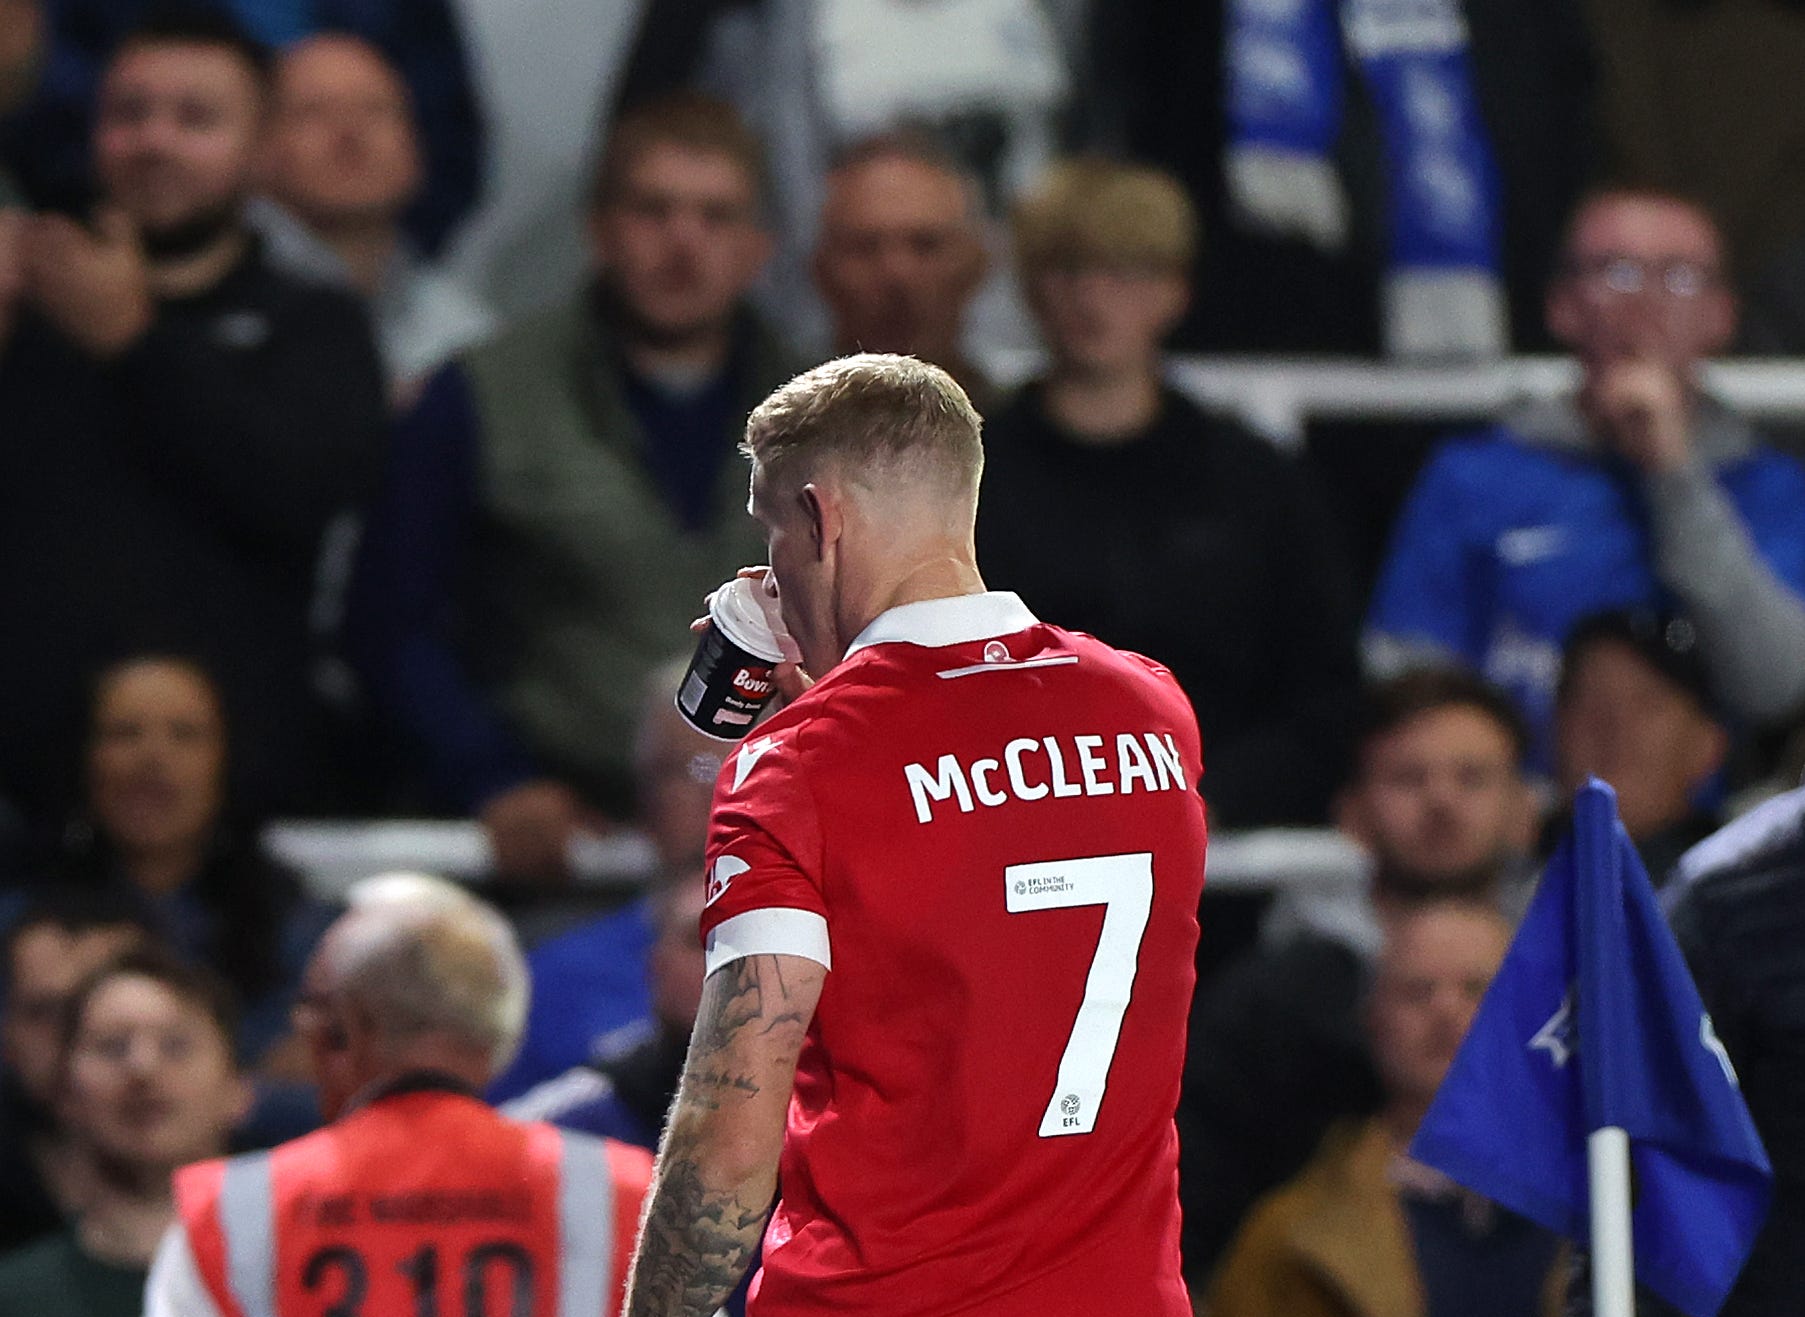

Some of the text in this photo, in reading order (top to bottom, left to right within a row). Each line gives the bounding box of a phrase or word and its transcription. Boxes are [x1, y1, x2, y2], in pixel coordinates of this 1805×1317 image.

[733, 669, 771, 692] Bovr
[903, 733, 1187, 824] McCLEAN
[1028, 878, 1042, 887] EFL
[1053, 875, 1065, 884] THE
[1029, 882, 1074, 895] COMMUNITY
[1005, 852, 1154, 1137] 7
[1062, 1117, 1081, 1127] EFL
